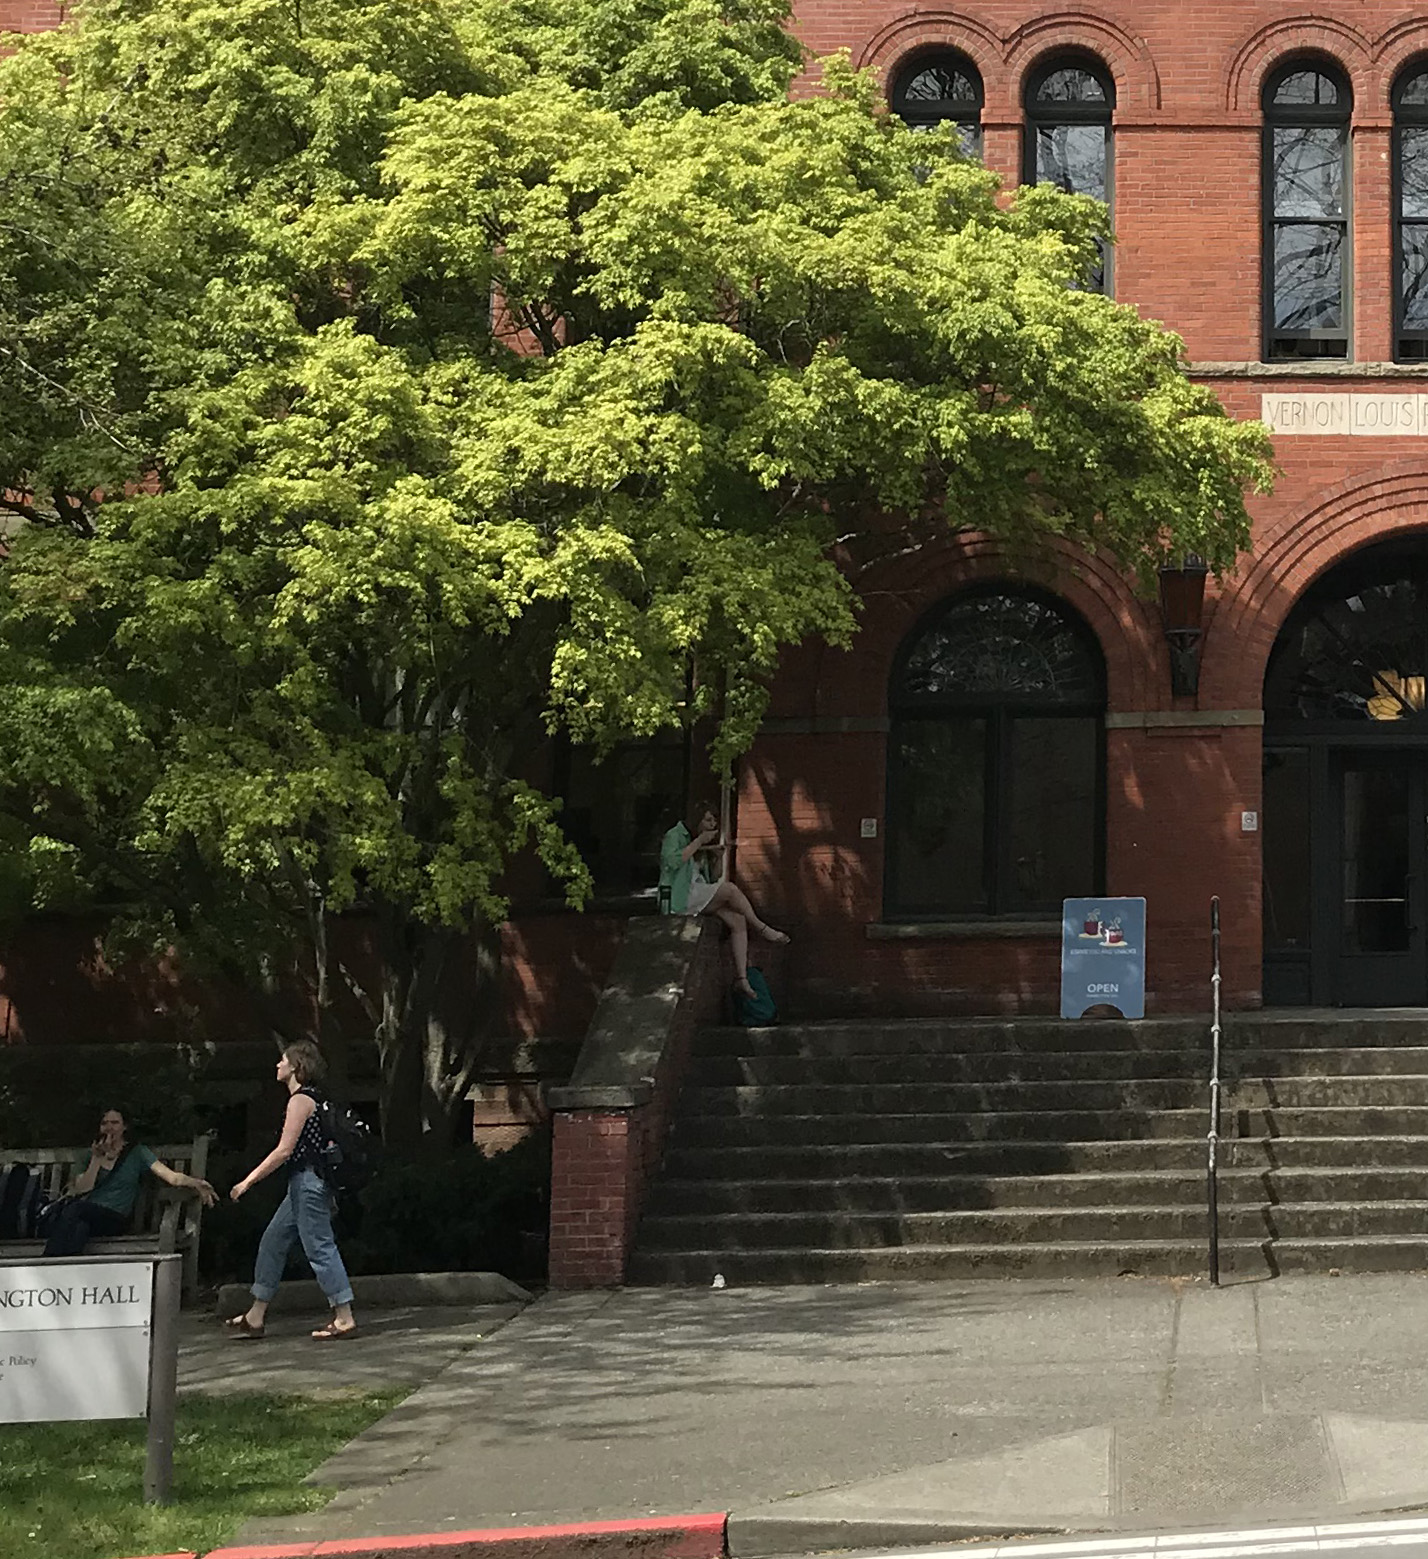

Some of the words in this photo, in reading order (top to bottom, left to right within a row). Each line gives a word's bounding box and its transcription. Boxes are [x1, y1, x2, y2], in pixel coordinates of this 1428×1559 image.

[1267, 400, 1343, 427] VERNON
[1355, 400, 1414, 427] LOUIS
[1087, 983, 1119, 993] OPEN
[81, 1285, 140, 1305] HALL
